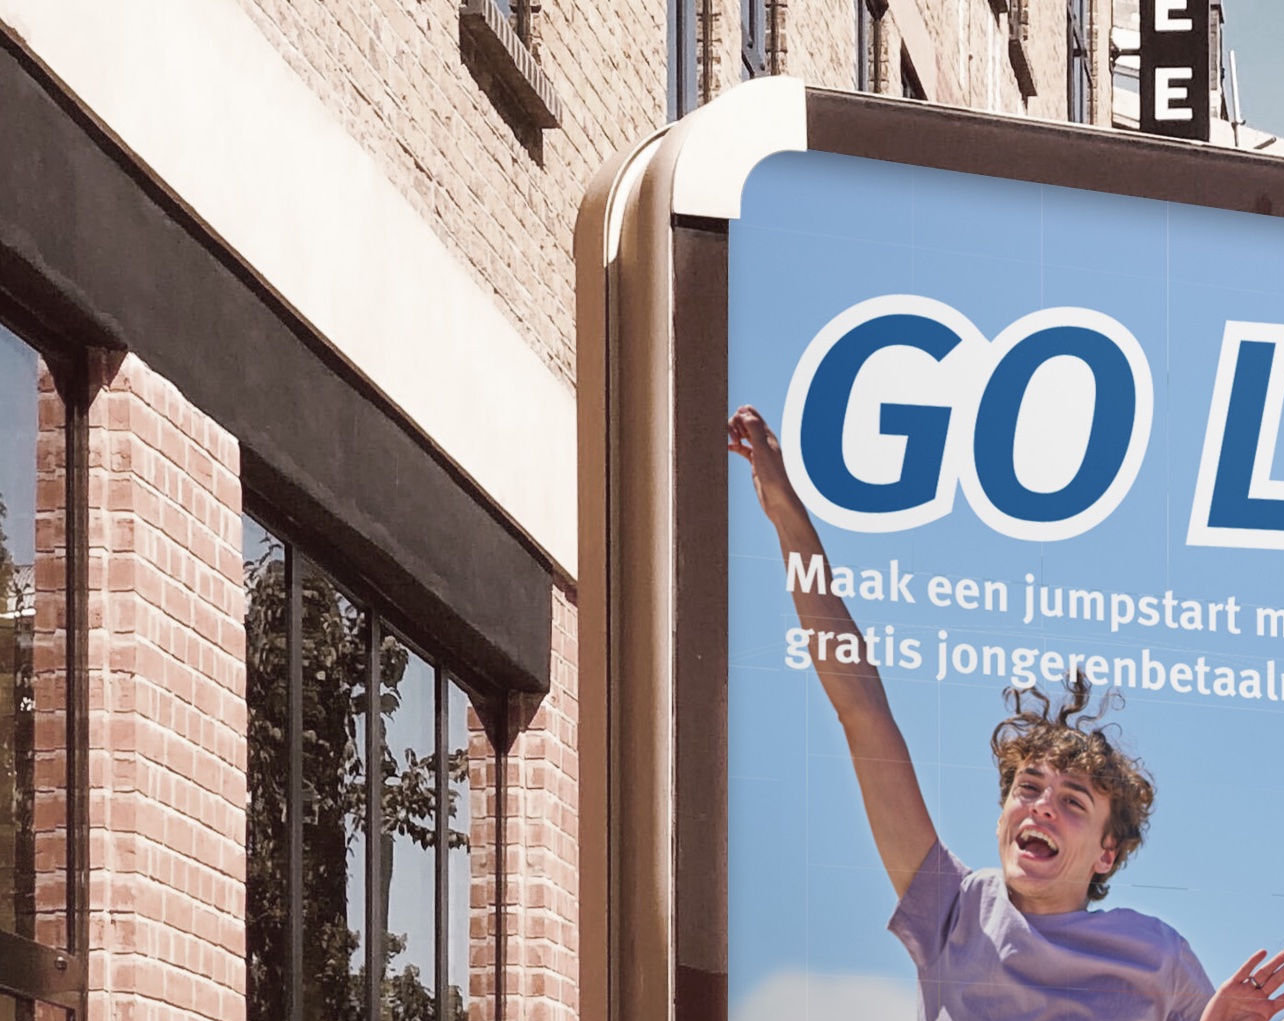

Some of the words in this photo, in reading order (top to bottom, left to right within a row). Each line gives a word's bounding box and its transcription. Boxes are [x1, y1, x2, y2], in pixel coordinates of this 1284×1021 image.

[798, 313, 1136, 522] GO
[786, 552, 916, 603] Maak
[927, 576, 1007, 612] een
[1023, 573, 1241, 634] jumpstart
[785, 625, 922, 670] gratis
